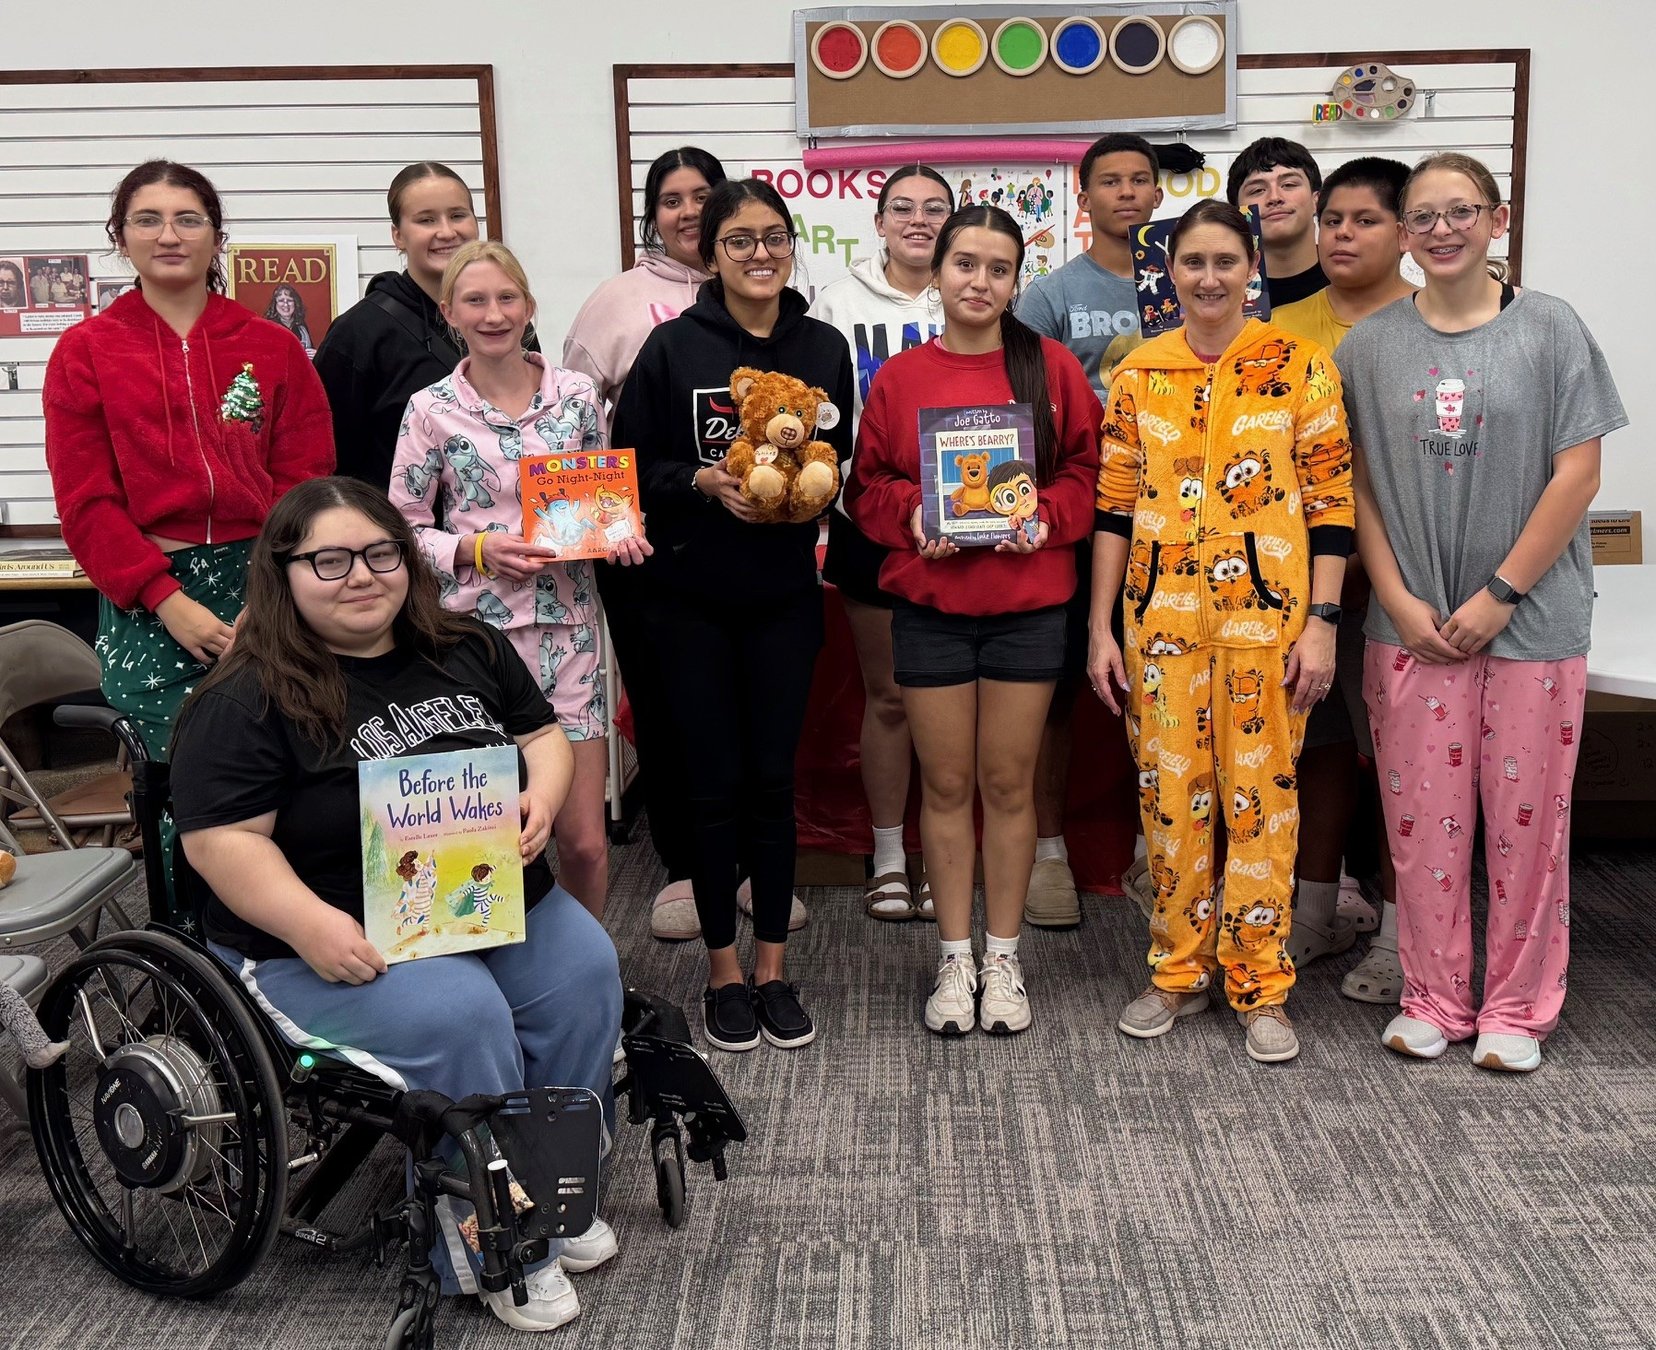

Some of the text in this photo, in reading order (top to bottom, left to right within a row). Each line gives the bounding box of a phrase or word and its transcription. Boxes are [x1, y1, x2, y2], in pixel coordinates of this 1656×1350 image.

[1315, 103, 1343, 121] READ
[792, 213, 859, 268] ART
[238, 258, 327, 284] READ
[954, 412, 1001, 427] Joe Gatto
[939, 433, 1015, 448] WHERE'S BEARRY?
[1420, 438, 1479, 457] TRUE LOVE
[529, 455, 630, 478] MONSTERS
[537, 471, 625, 486] Go Night-Night
[1221, 619, 1278, 645] GARFIELD
[399, 762, 488, 798] Before the
[387, 791, 503, 829] World Wakes
